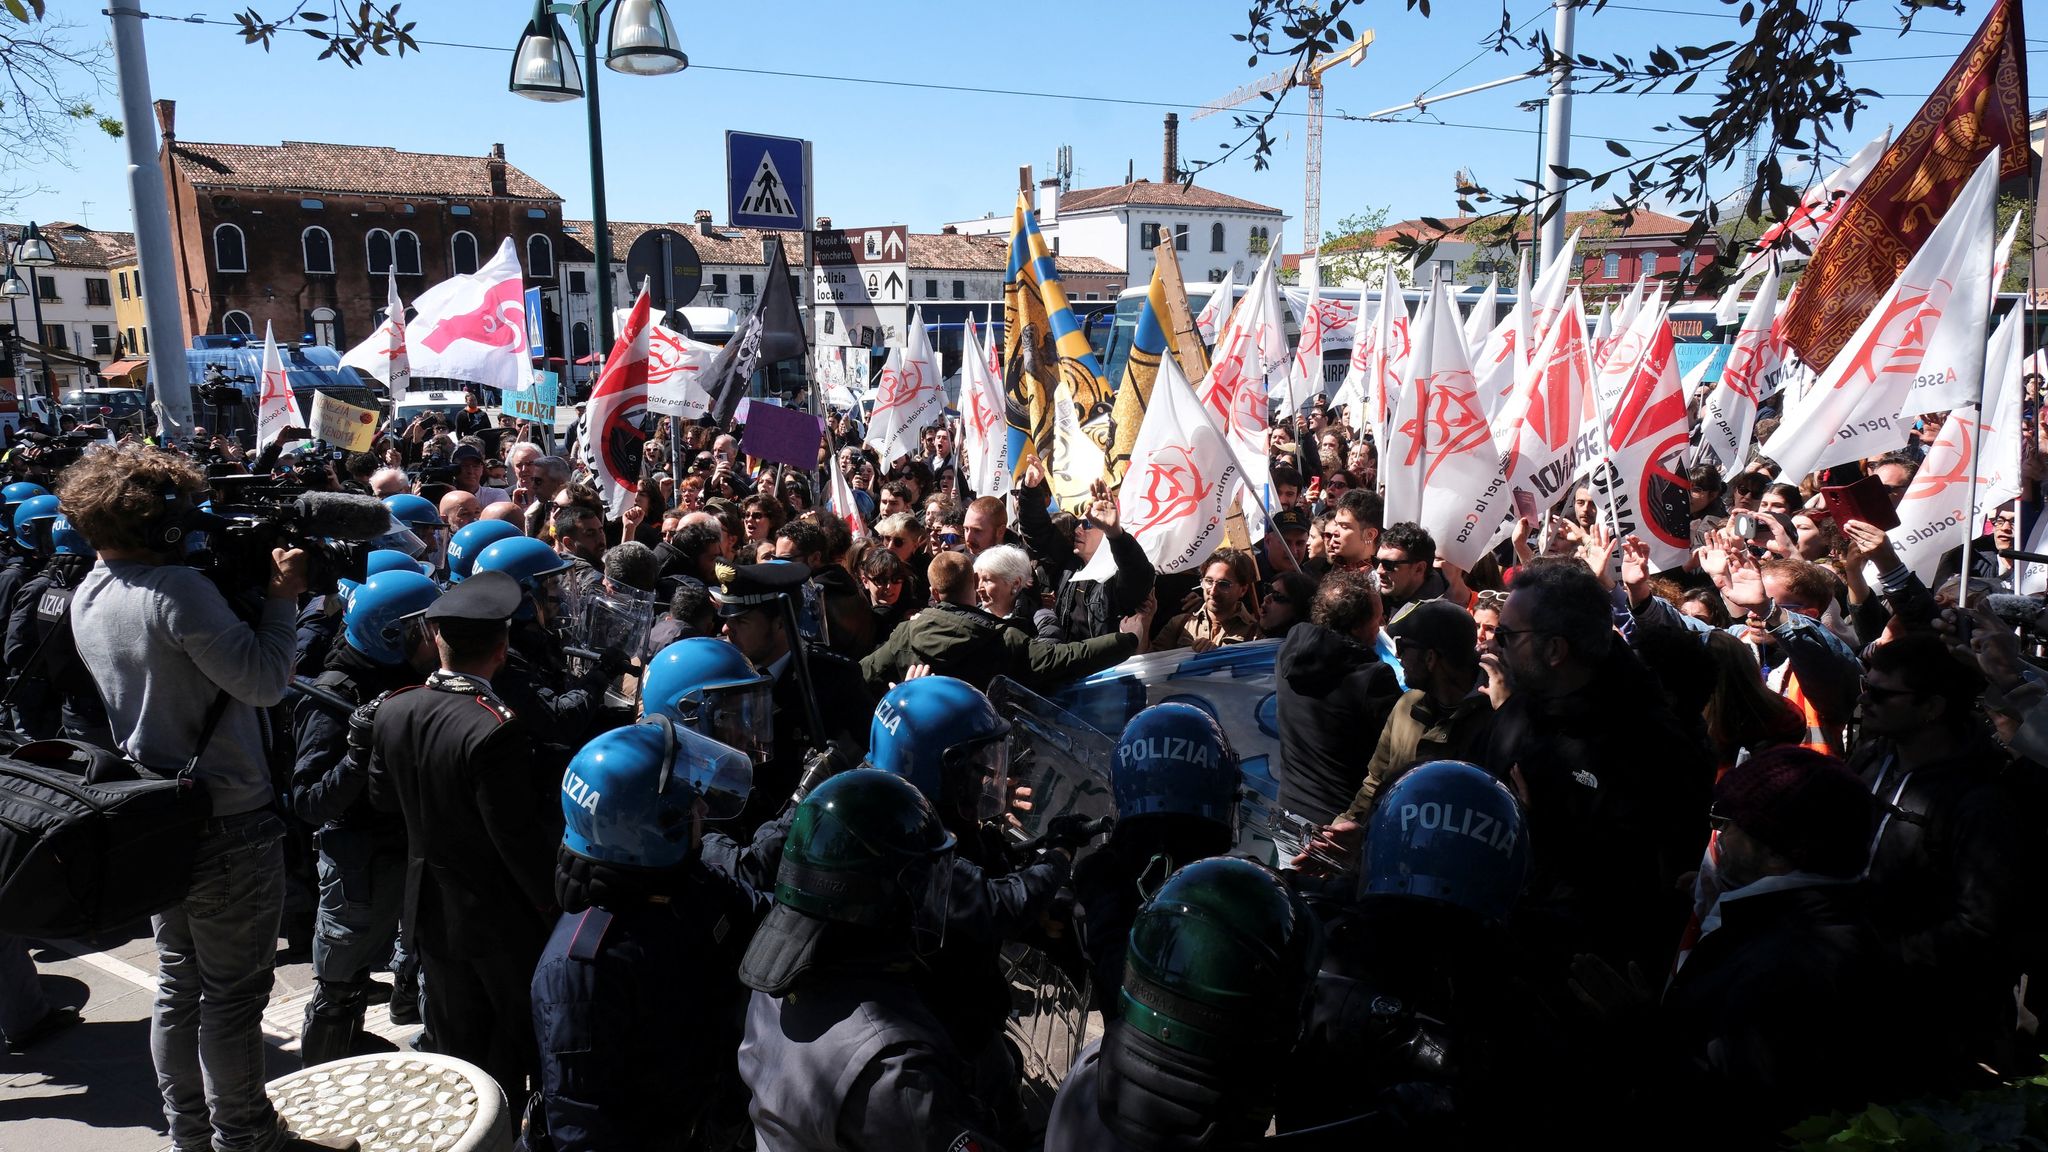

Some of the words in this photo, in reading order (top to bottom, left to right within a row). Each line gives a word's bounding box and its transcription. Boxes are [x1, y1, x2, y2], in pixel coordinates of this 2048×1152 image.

[815, 236, 838, 246] People
[841, 236, 861, 245] Mover
[815, 251, 851, 261] Tronchetto
[817, 272, 846, 286] polizia
[817, 289, 844, 300] locale
[284, 364, 339, 373] LIZIA
[1716, 420, 1732, 436] per
[1120, 737, 1208, 768] POLIZIA
[1401, 802, 1516, 859] POLIZIA
